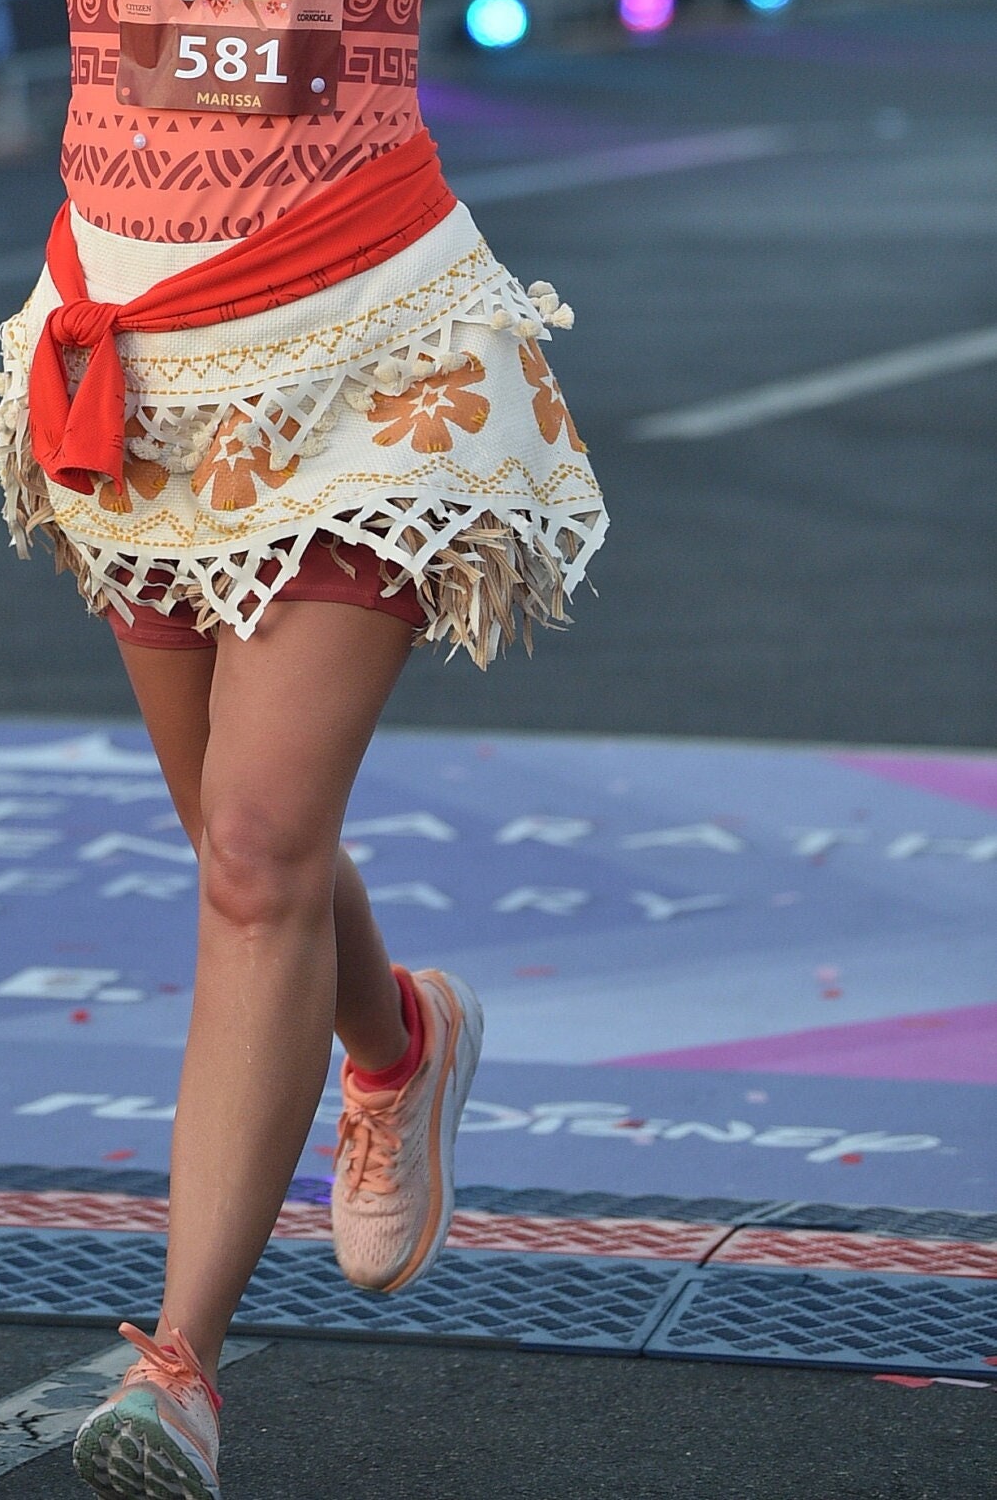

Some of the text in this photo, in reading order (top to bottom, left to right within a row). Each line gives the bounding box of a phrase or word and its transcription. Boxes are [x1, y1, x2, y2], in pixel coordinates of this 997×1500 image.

[125, 4, 152, 12] CITIZEN
[174, 35, 288, 84] 581
[196, 92, 262, 108] MARISSA
